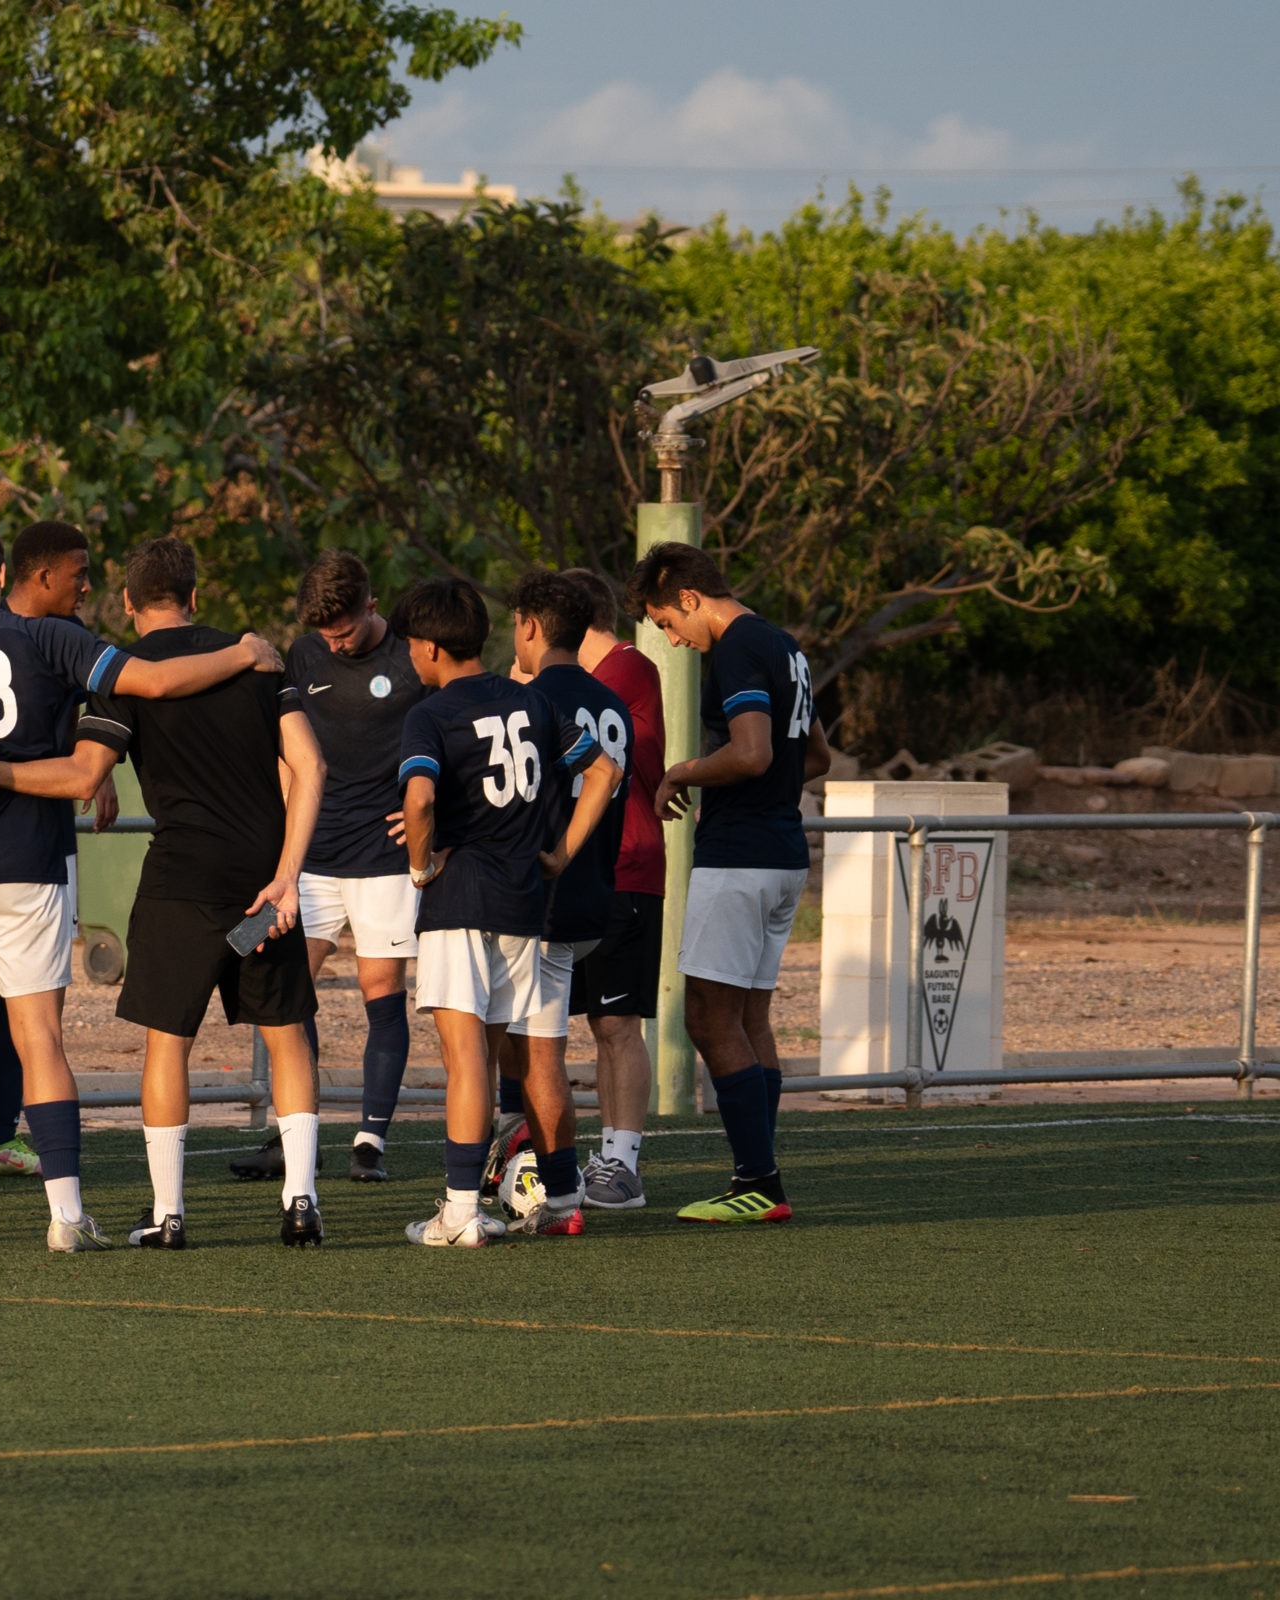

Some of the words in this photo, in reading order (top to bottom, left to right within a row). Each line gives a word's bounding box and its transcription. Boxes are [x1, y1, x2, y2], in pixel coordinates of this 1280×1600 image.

[472, 710, 542, 808] 36
[924, 969, 960, 979] SAGUNTO
[927, 982, 956, 991] FUTBOL
[932, 994, 952, 1004] BASE
